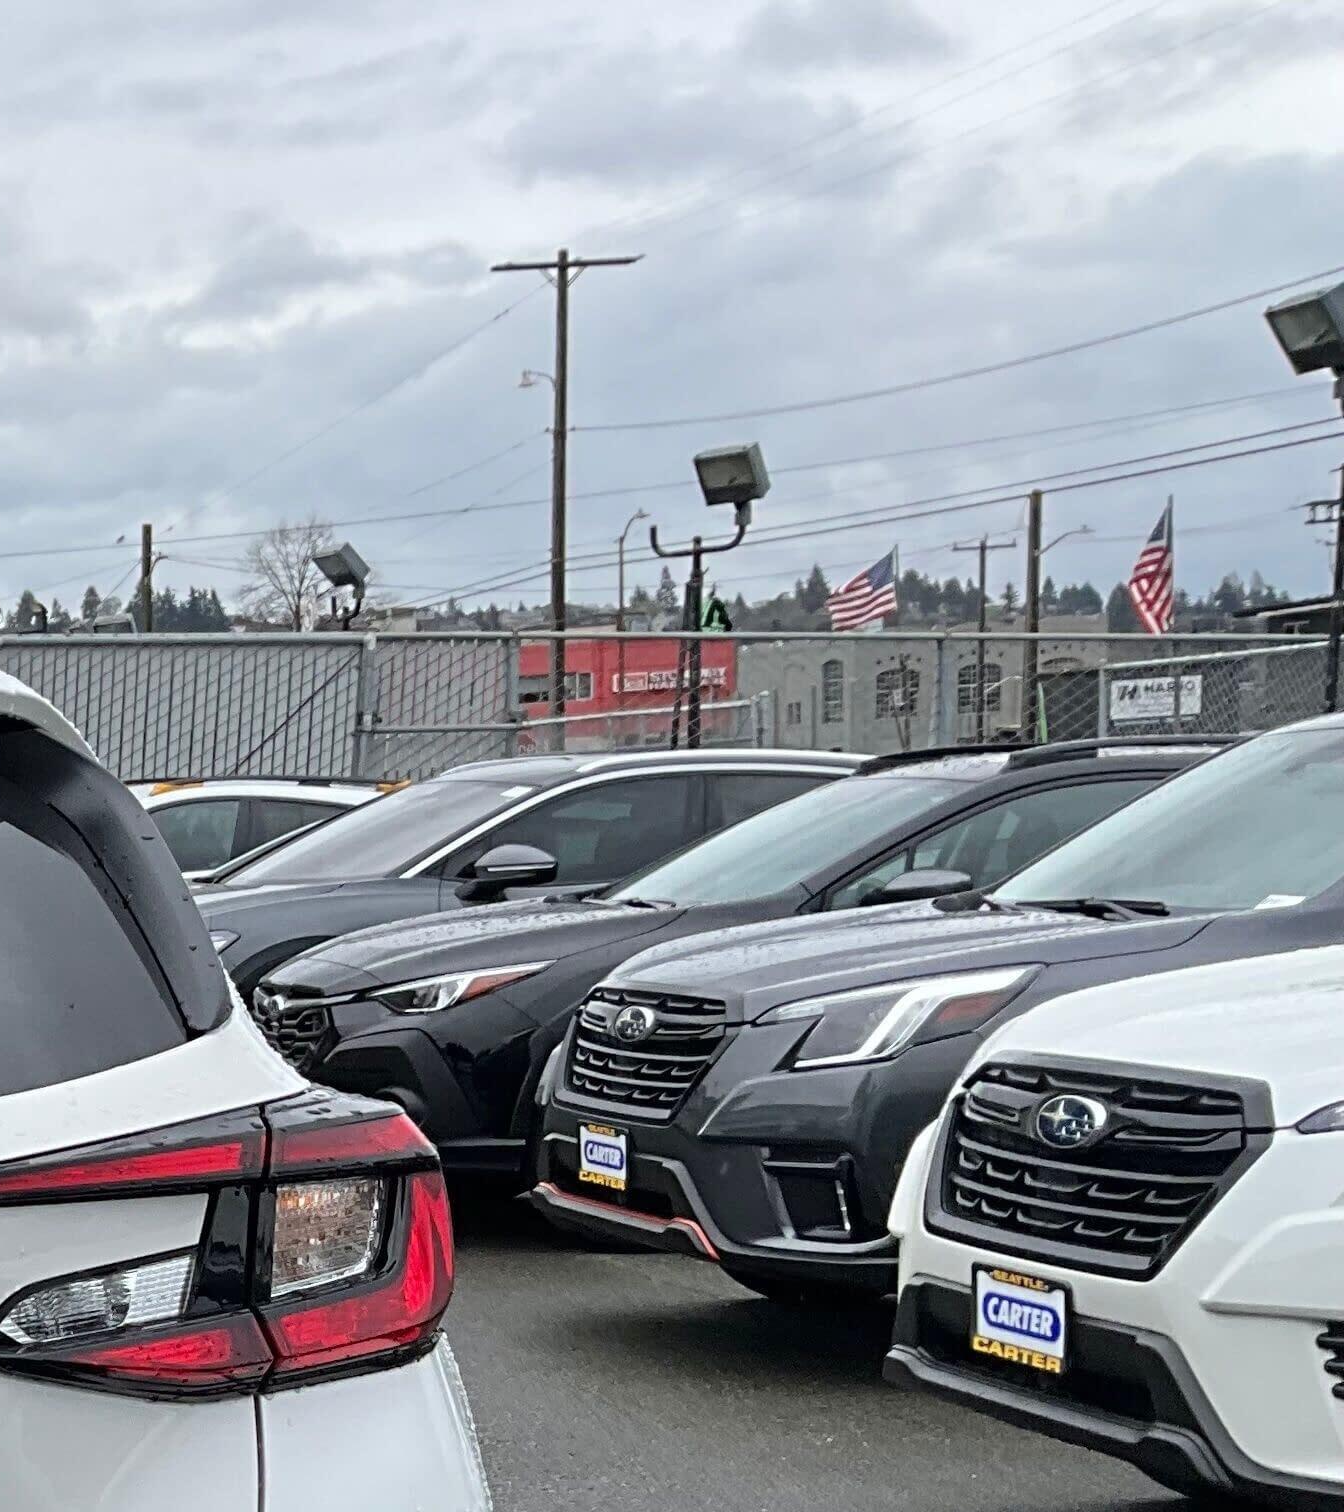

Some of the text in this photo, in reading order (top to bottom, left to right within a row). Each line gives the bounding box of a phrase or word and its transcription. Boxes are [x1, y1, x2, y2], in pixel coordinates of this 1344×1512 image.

[587, 1143, 621, 1167] CARTER
[579, 1170, 625, 1191] CARTER
[992, 1269, 1045, 1291] SEATTLE
[987, 1297, 1053, 1337] CARTER
[973, 1336, 1061, 1374] CARTER
